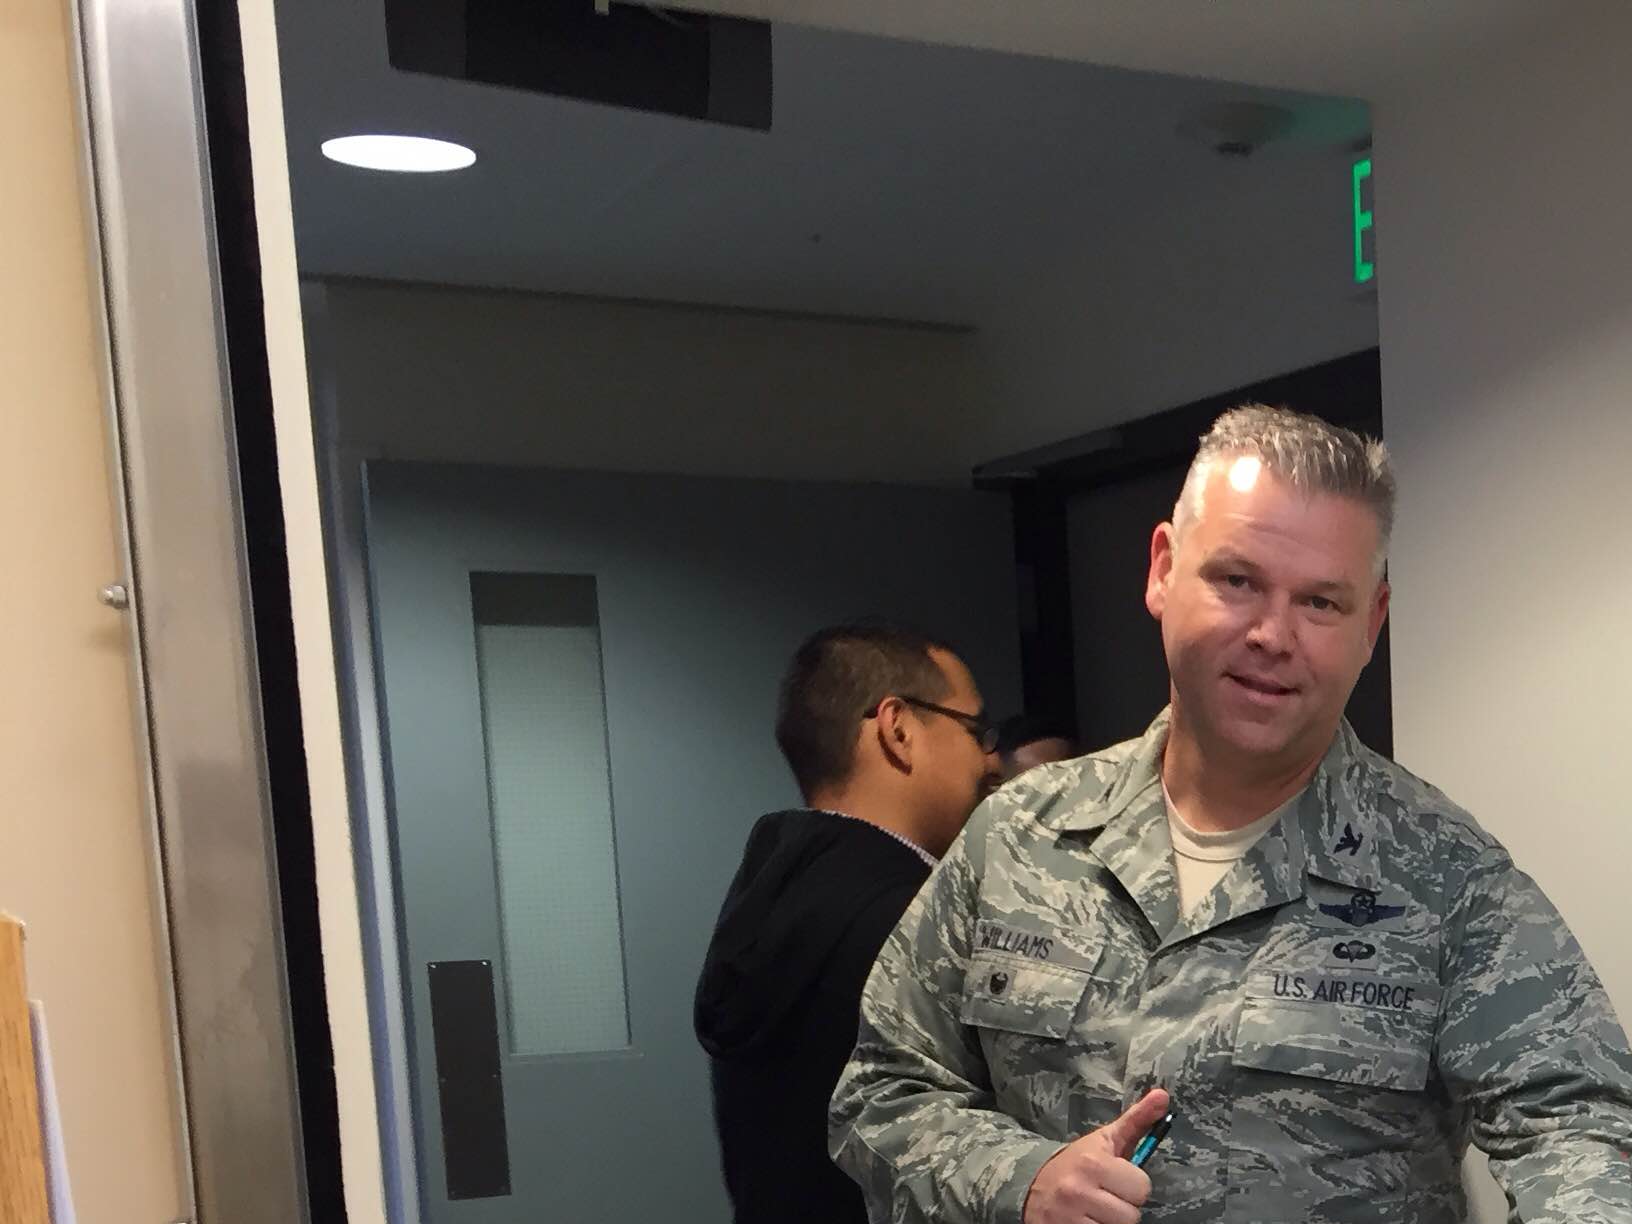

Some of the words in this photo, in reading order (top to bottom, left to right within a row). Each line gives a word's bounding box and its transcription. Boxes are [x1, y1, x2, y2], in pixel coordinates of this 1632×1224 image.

[1274, 974, 1308, 998] U.S.
[1313, 979, 1348, 1003] AIR
[1351, 982, 1415, 1010] FORCE
